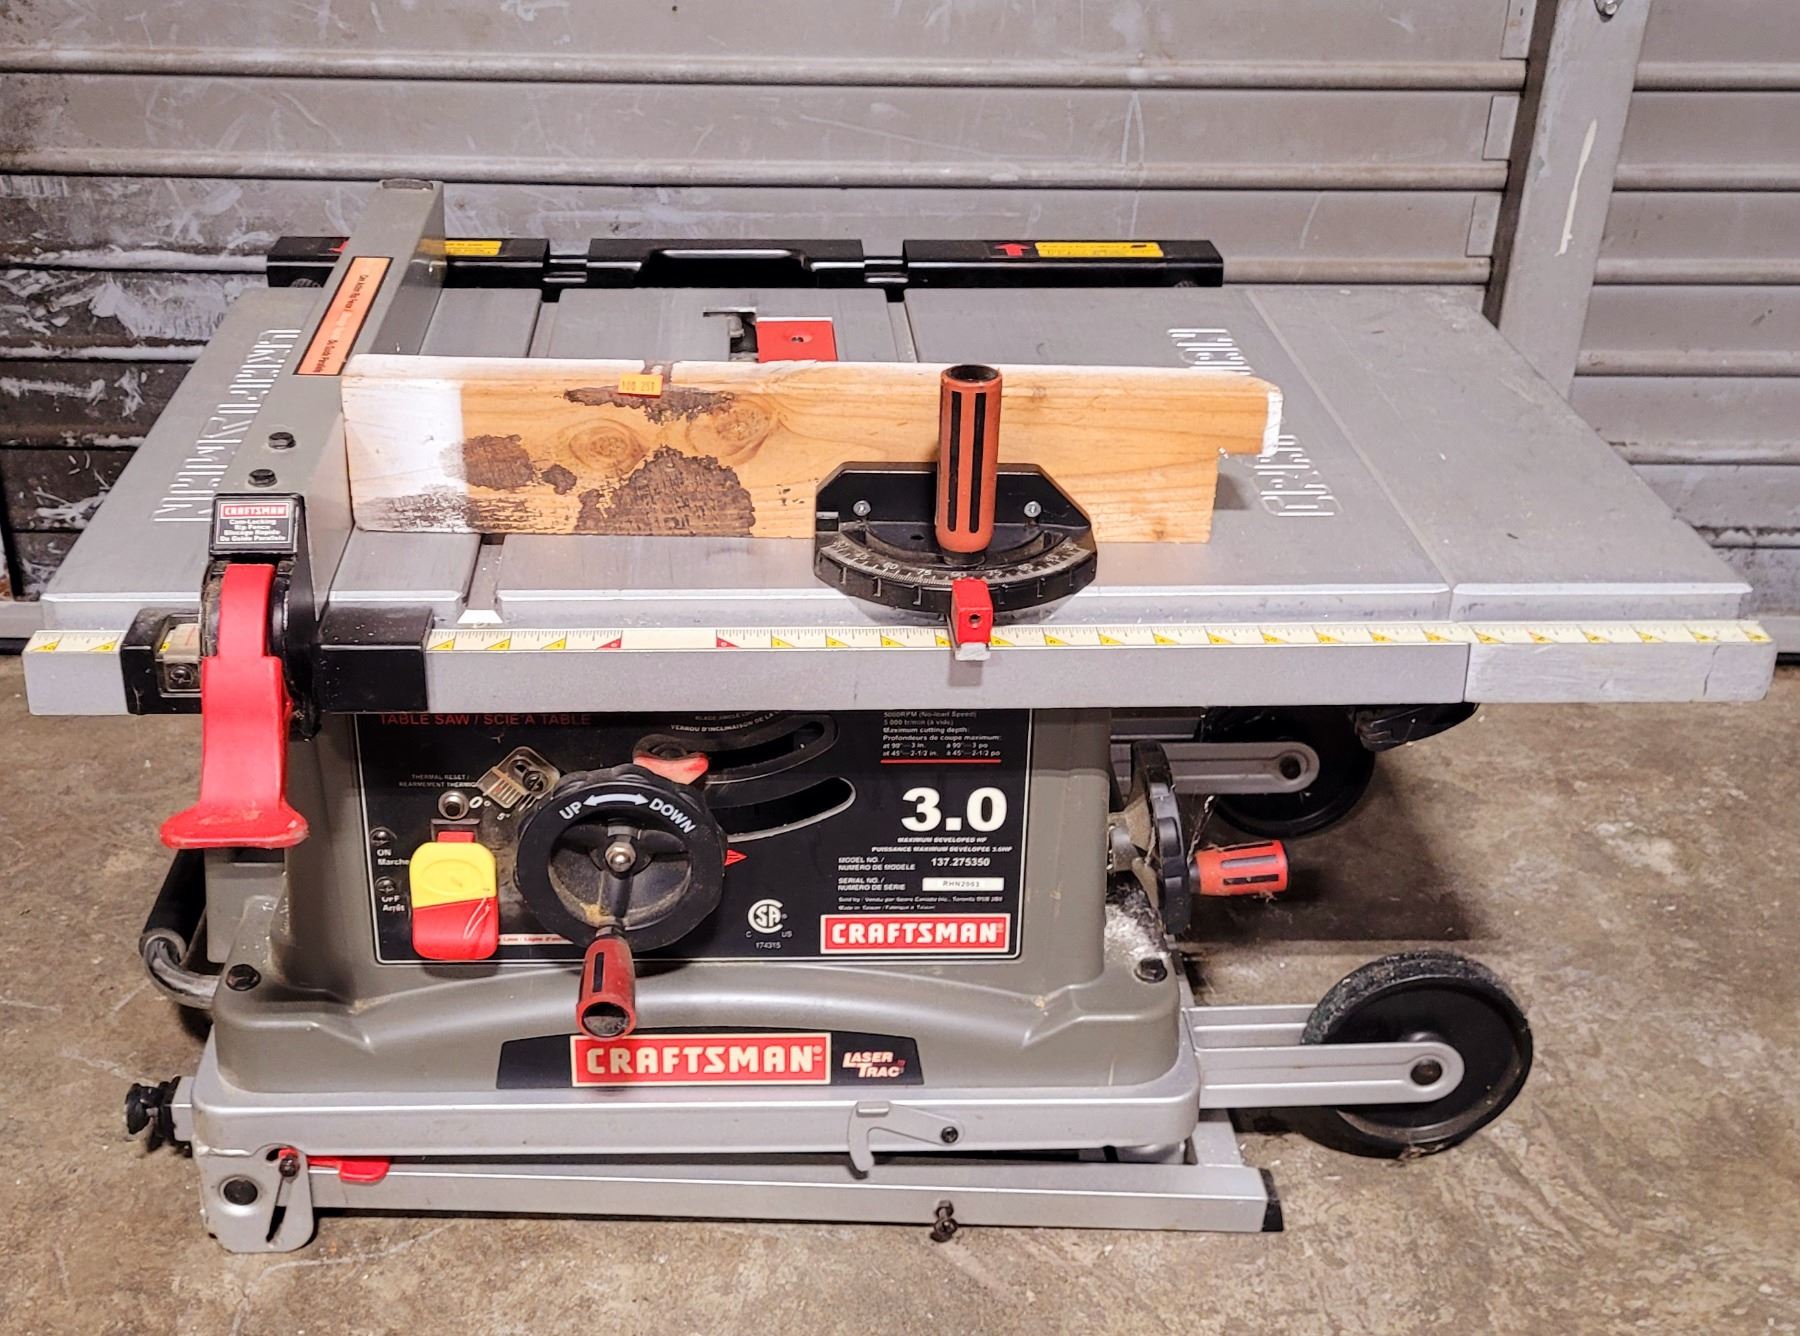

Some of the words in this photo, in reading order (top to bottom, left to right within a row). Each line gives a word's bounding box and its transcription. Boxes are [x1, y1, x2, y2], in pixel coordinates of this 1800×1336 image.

[224, 506, 285, 516] CRAFTSMAN
[379, 713, 430, 725] TABLE
[434, 713, 470, 725] SAW
[483, 713, 520, 725] SCIE
[542, 713, 592, 725] TABLE
[559, 801, 582, 820] UP
[648, 798, 697, 834] DOWN
[901, 787, 1008, 832] 3.0
[377, 858, 410, 866] Marche
[838, 856, 865, 864] MODEL
[931, 857, 991, 867] 137.275350
[831, 922, 998, 944] CRAFTSMAN
[586, 1045, 814, 1075] CRAFTSMAN
[842, 1051, 894, 1069] LASER
[857, 1063, 901, 1078] TRAC
